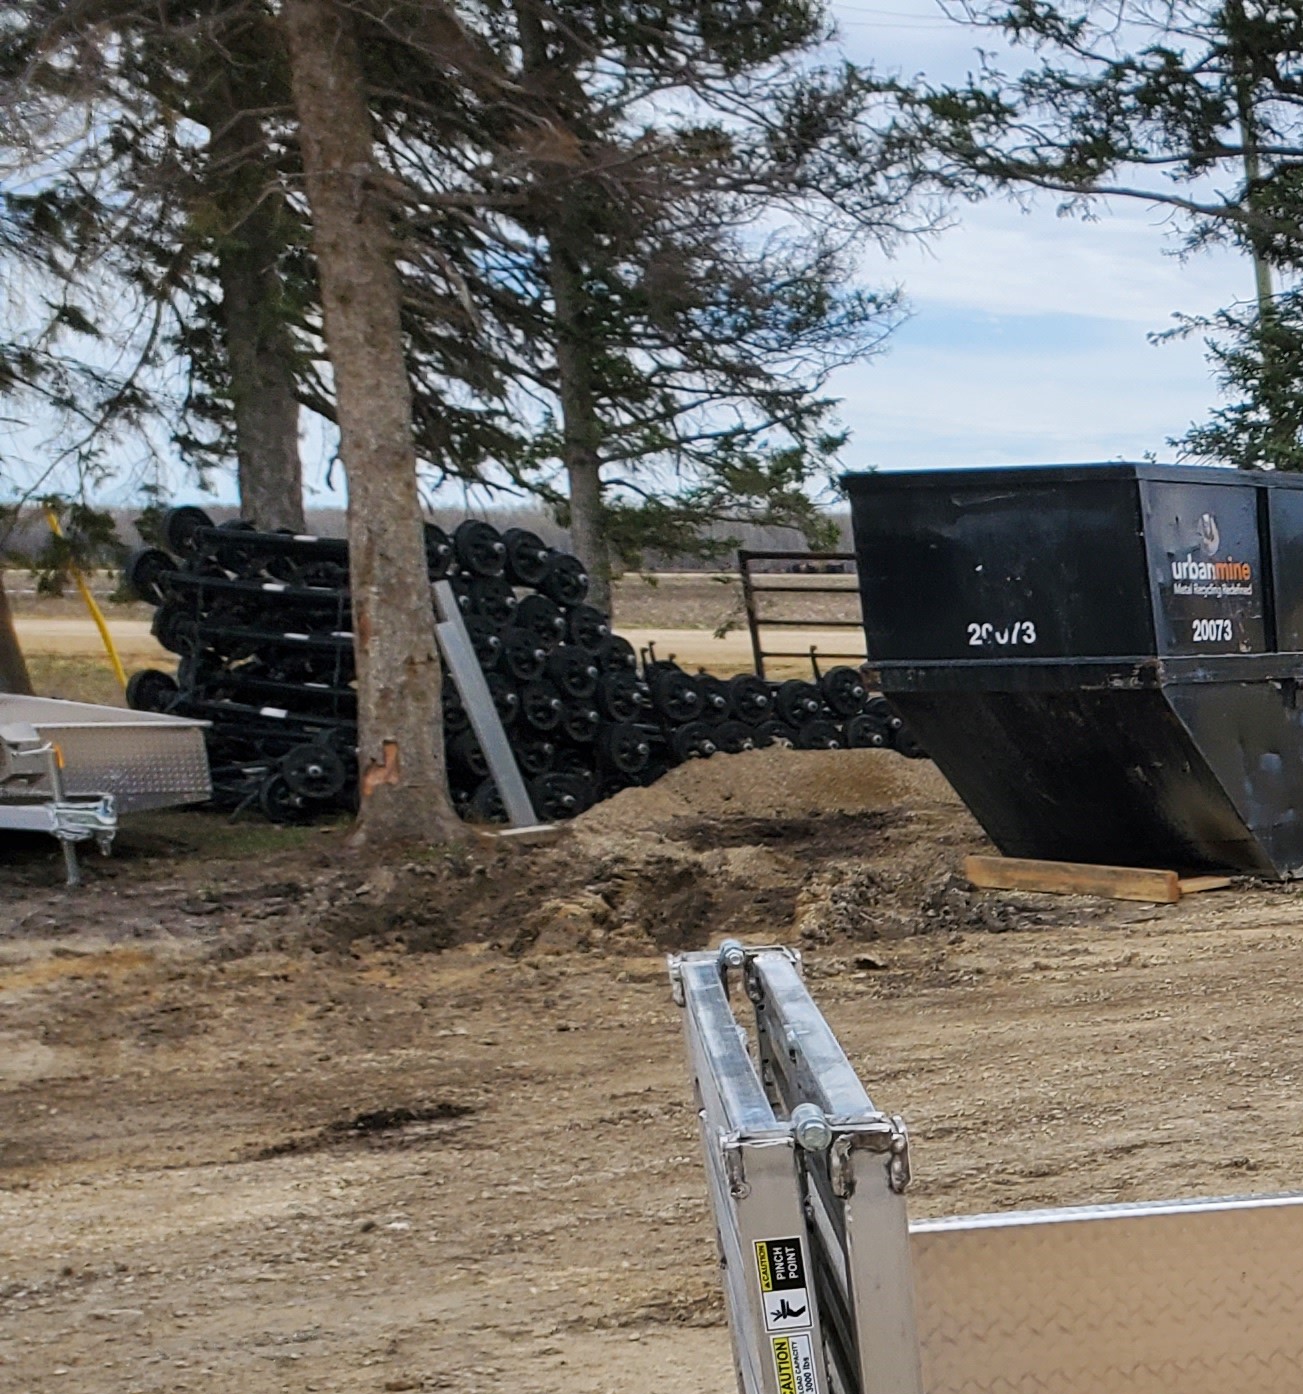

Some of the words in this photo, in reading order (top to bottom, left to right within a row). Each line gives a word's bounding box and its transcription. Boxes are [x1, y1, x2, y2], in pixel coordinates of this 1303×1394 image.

[1171, 552, 1251, 580] urbanmine
[1192, 618, 1233, 642] 20073
[757, 1245, 770, 1282] CAUTION
[772, 1246, 787, 1281] PINCH
[785, 1246, 799, 1279] POINT
[791, 1341, 801, 1374] CAPACITY
[796, 1375, 805, 1394] LOAD
[803, 1372, 814, 1393] 3000
